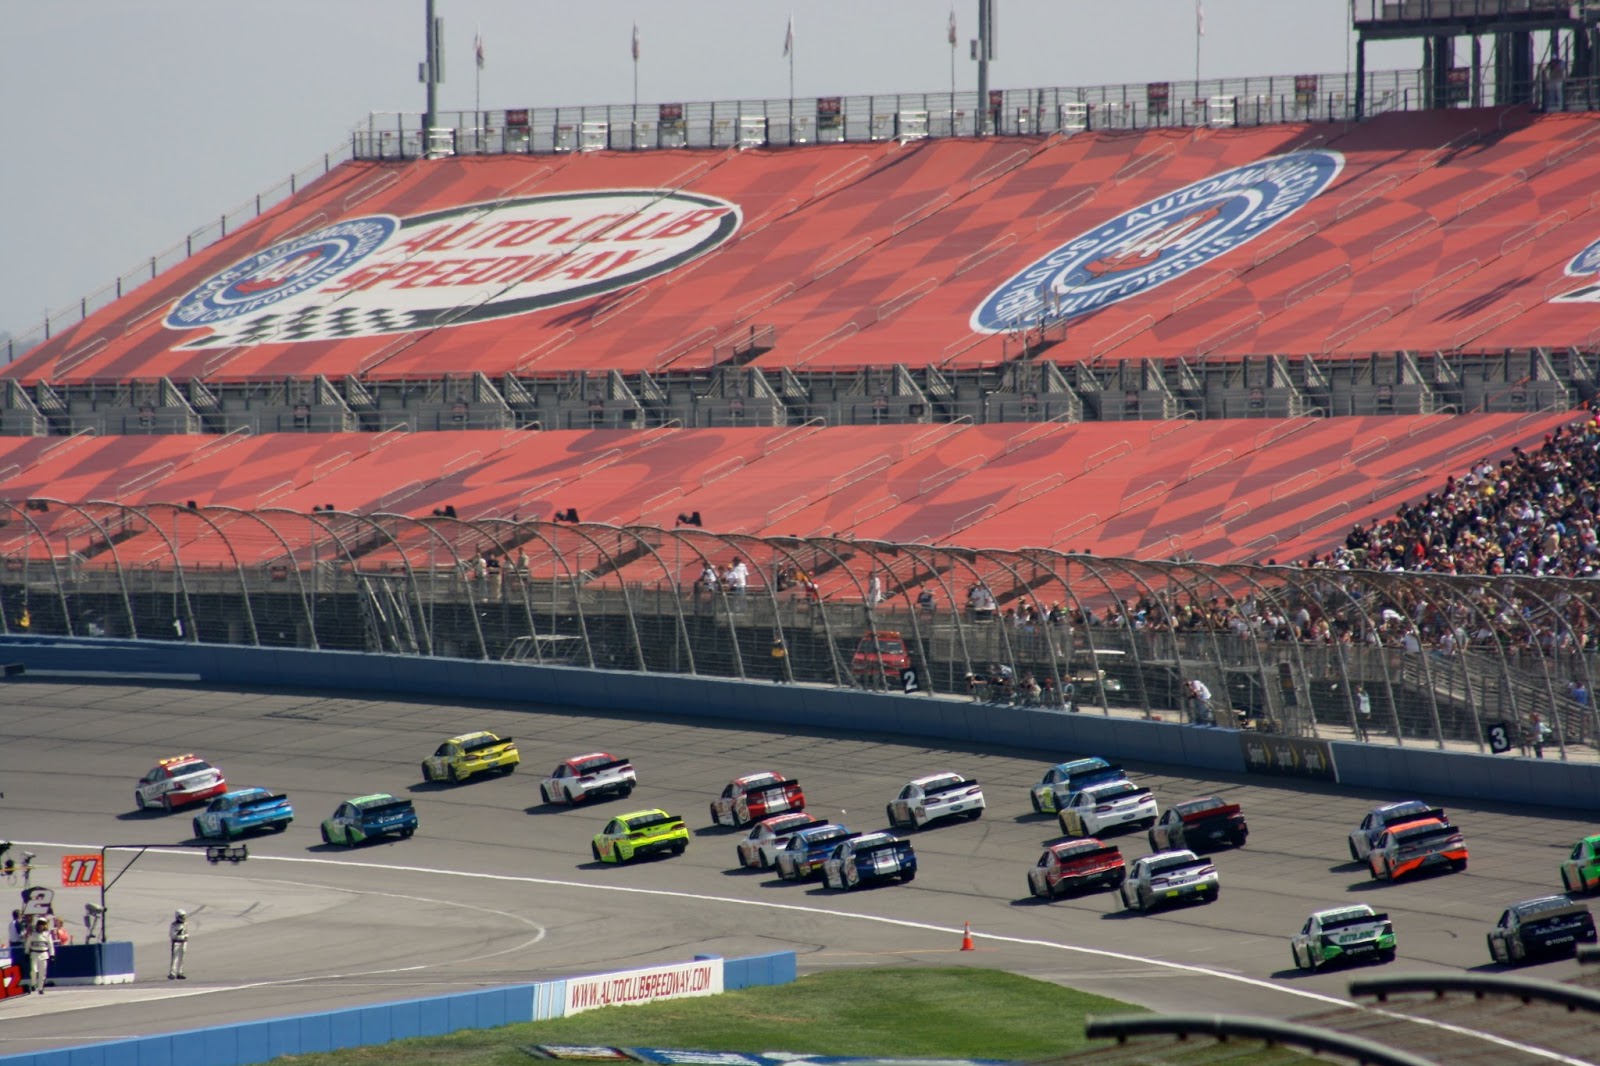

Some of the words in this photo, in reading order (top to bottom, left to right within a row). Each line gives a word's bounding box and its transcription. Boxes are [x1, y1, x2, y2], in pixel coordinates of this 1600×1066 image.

[1250, 175, 1318, 221] CLUB
[377, 217, 572, 255] AUTO
[547, 207, 731, 245] CLUB
[1101, 215, 1225, 259] AAA
[317, 247, 665, 294] SPEEDWAY
[1024, 233, 1247, 322] CALIFORNIA
[200, 266, 345, 321] CALIFORNIA
[904, 671, 917, 690] 2
[1492, 727, 1507, 749] 3
[67, 859, 97, 882] 11
[1353, 945, 1375, 953] TOYOTA
[1552, 935, 1574, 944] TOYOTA
[571, 967, 711, 1008] WWW.AUTOCLUBSPEEDWAY.COM
